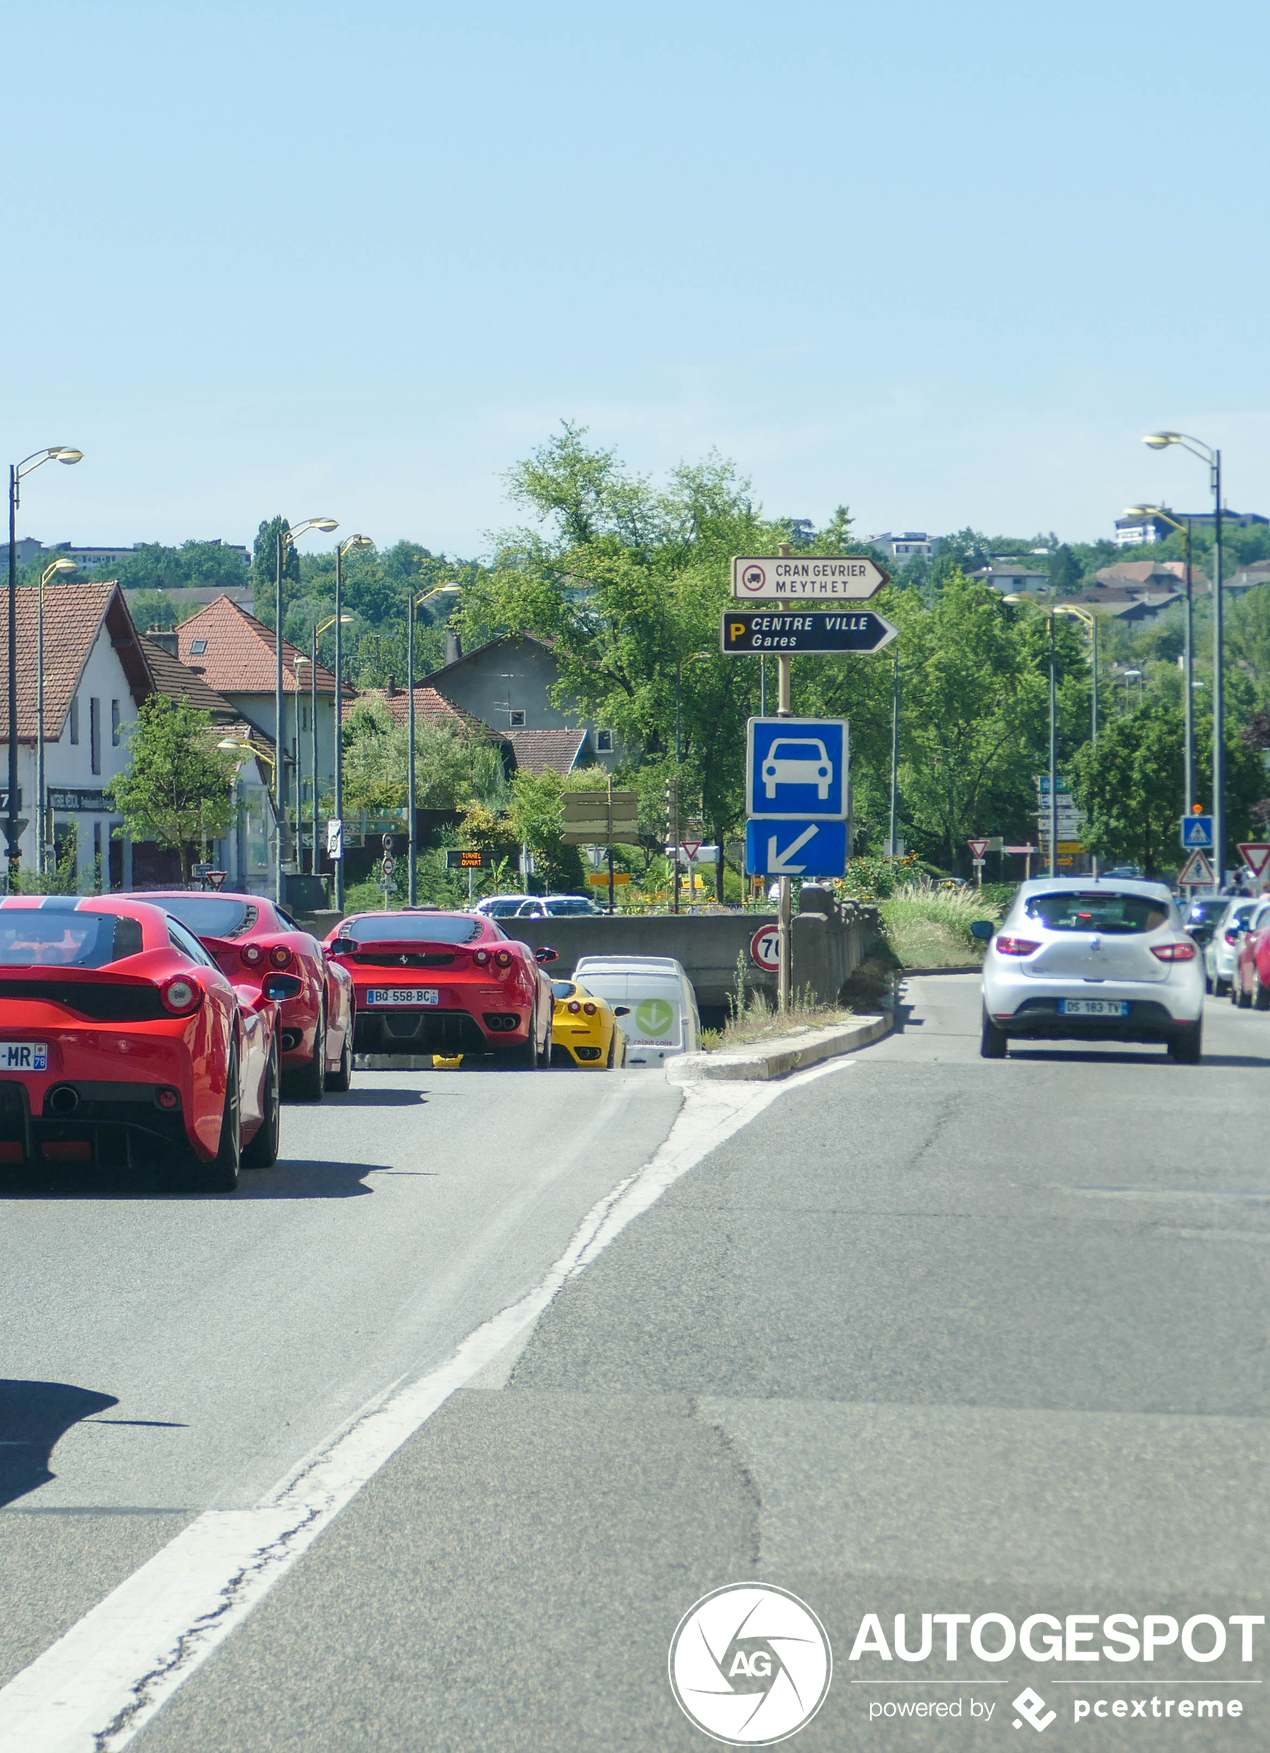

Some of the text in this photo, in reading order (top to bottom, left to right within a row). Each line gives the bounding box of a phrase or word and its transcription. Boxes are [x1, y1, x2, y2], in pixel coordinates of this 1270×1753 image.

[775, 564, 867, 577] CRAN GEVRIER
[775, 580, 849, 593] MEYTHET
[751, 617, 868, 631] CENTRE VILLE
[730, 623, 746, 642] P
[751, 634, 797, 647] Gares
